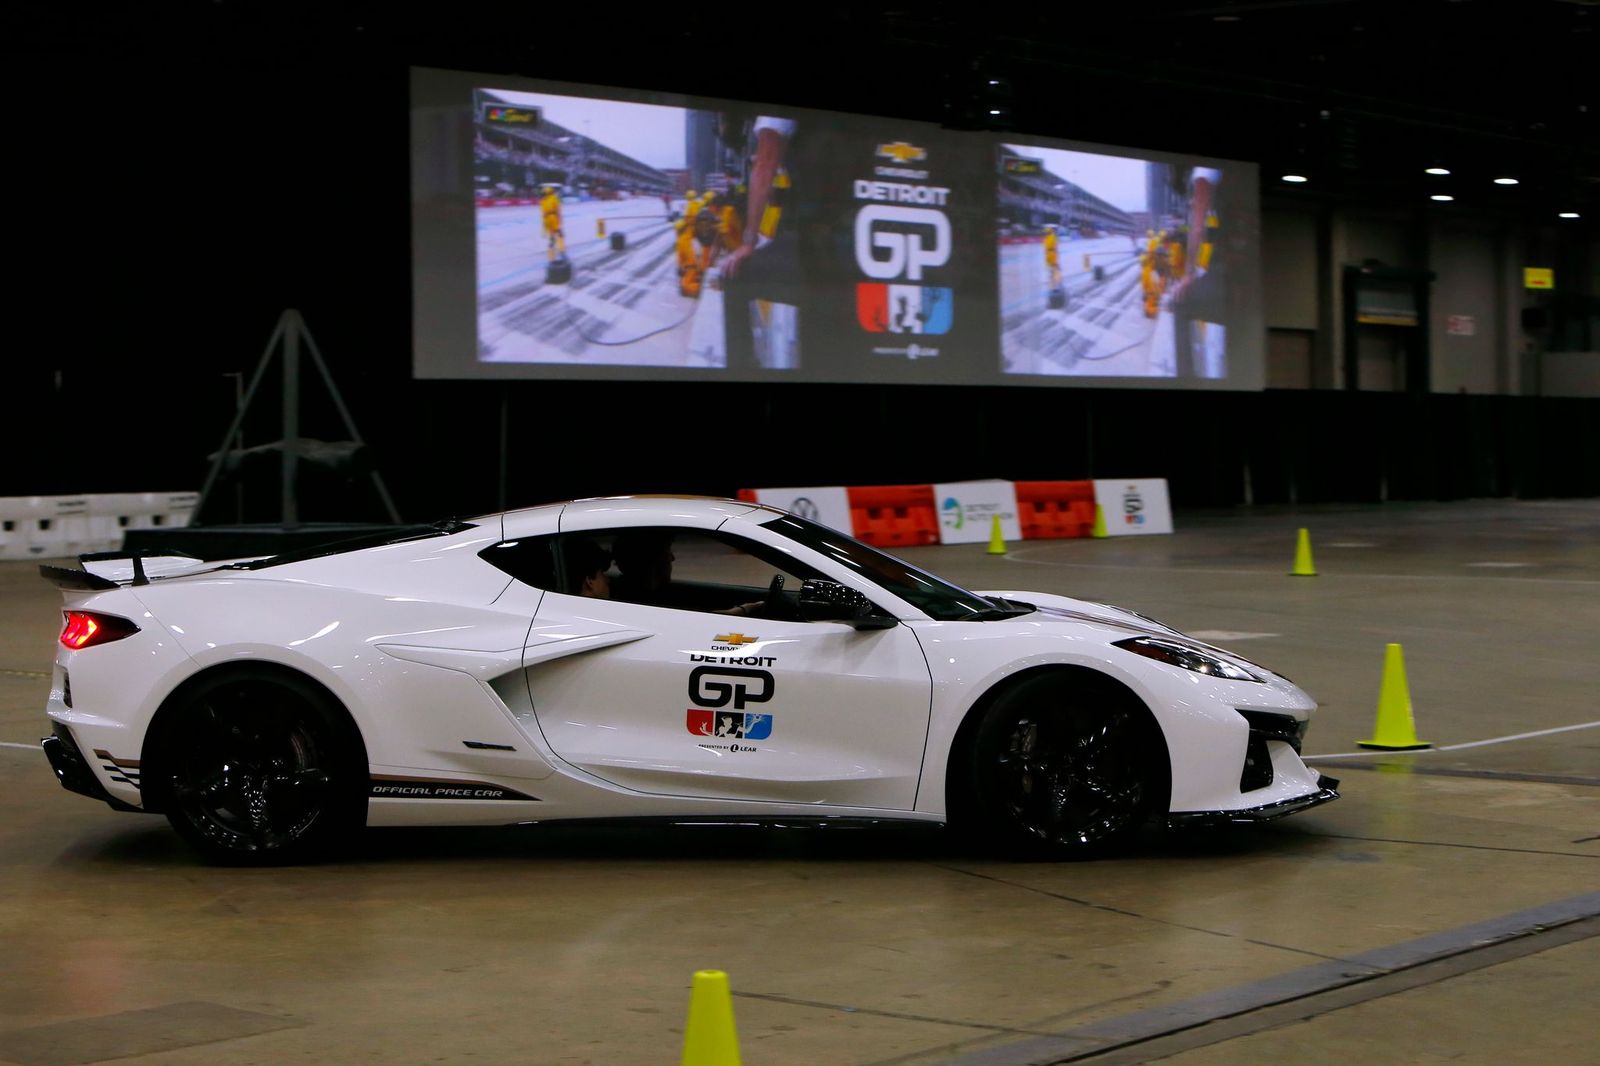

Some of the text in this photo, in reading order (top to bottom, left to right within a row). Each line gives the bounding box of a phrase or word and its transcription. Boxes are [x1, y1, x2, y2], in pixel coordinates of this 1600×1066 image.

[854, 180, 950, 205] DETROIT
[855, 204, 952, 280] GP
[690, 654, 777, 667] DETROIT
[688, 666, 775, 709] GP
[372, 786, 503, 797] OFFICIAL PACE CAR
